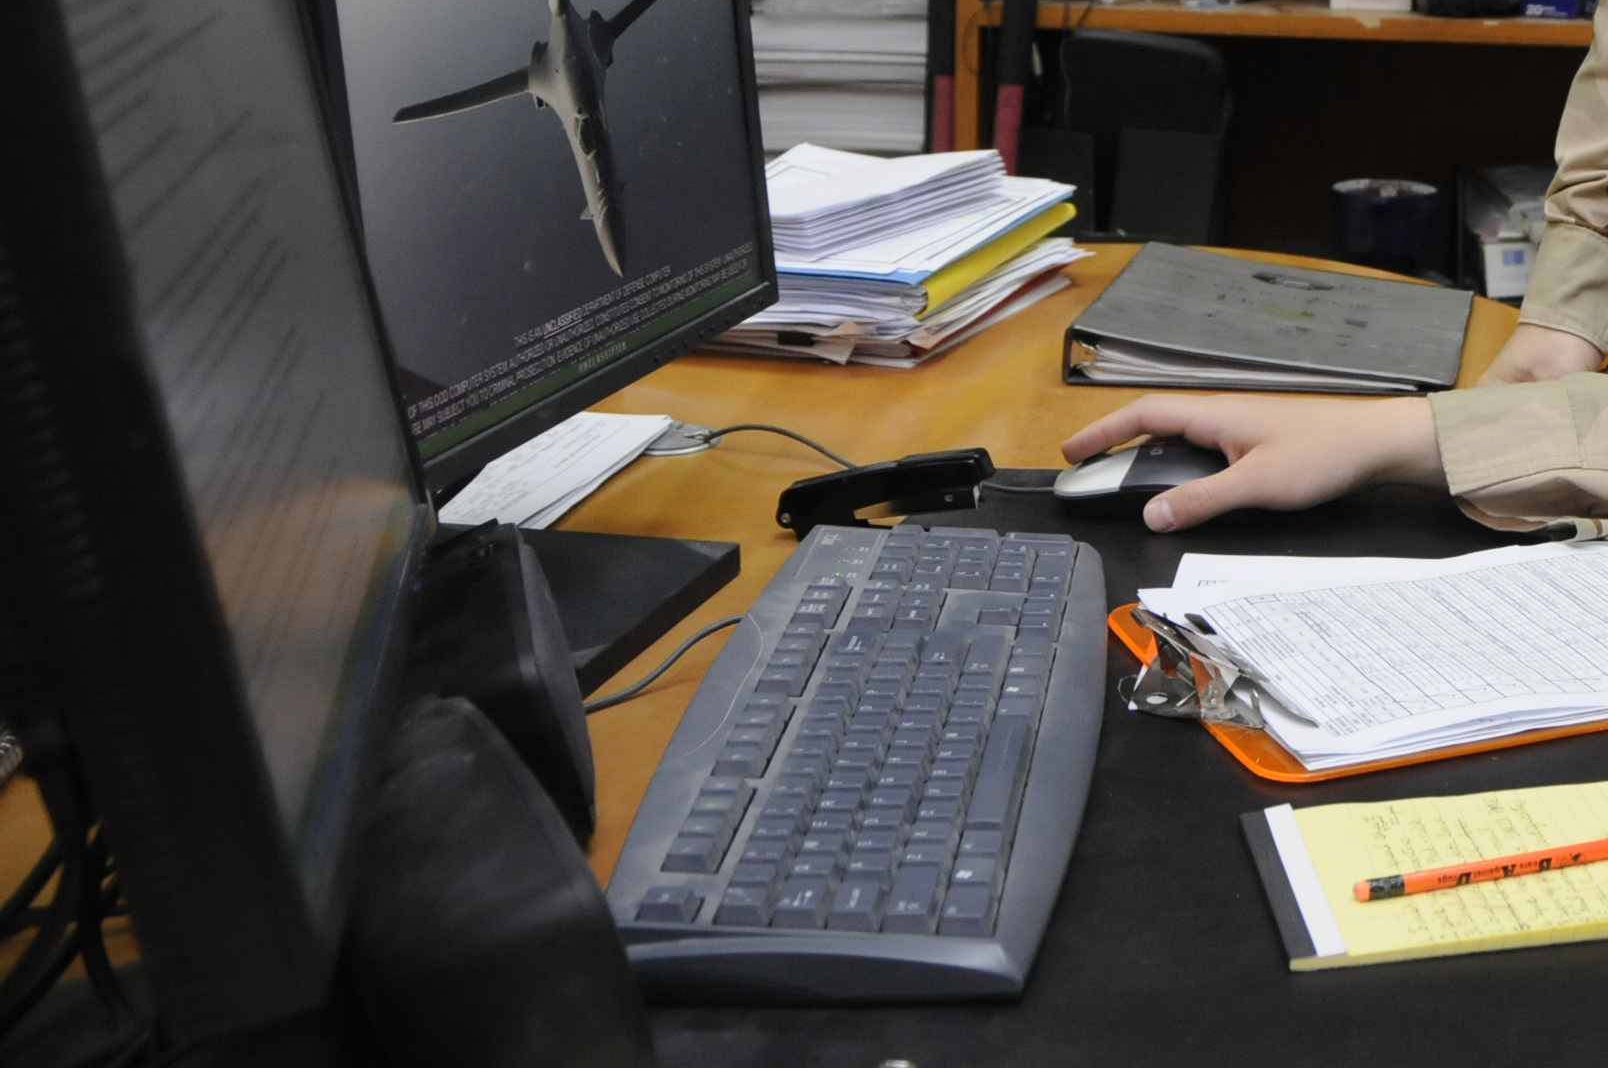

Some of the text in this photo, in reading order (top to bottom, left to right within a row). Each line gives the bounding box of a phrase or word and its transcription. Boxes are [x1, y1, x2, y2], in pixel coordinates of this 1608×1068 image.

[449, 373, 483, 397] COMPUTER
[1474, 864, 1516, 878] Against
[1437, 872, 1472, 885] Drugs
